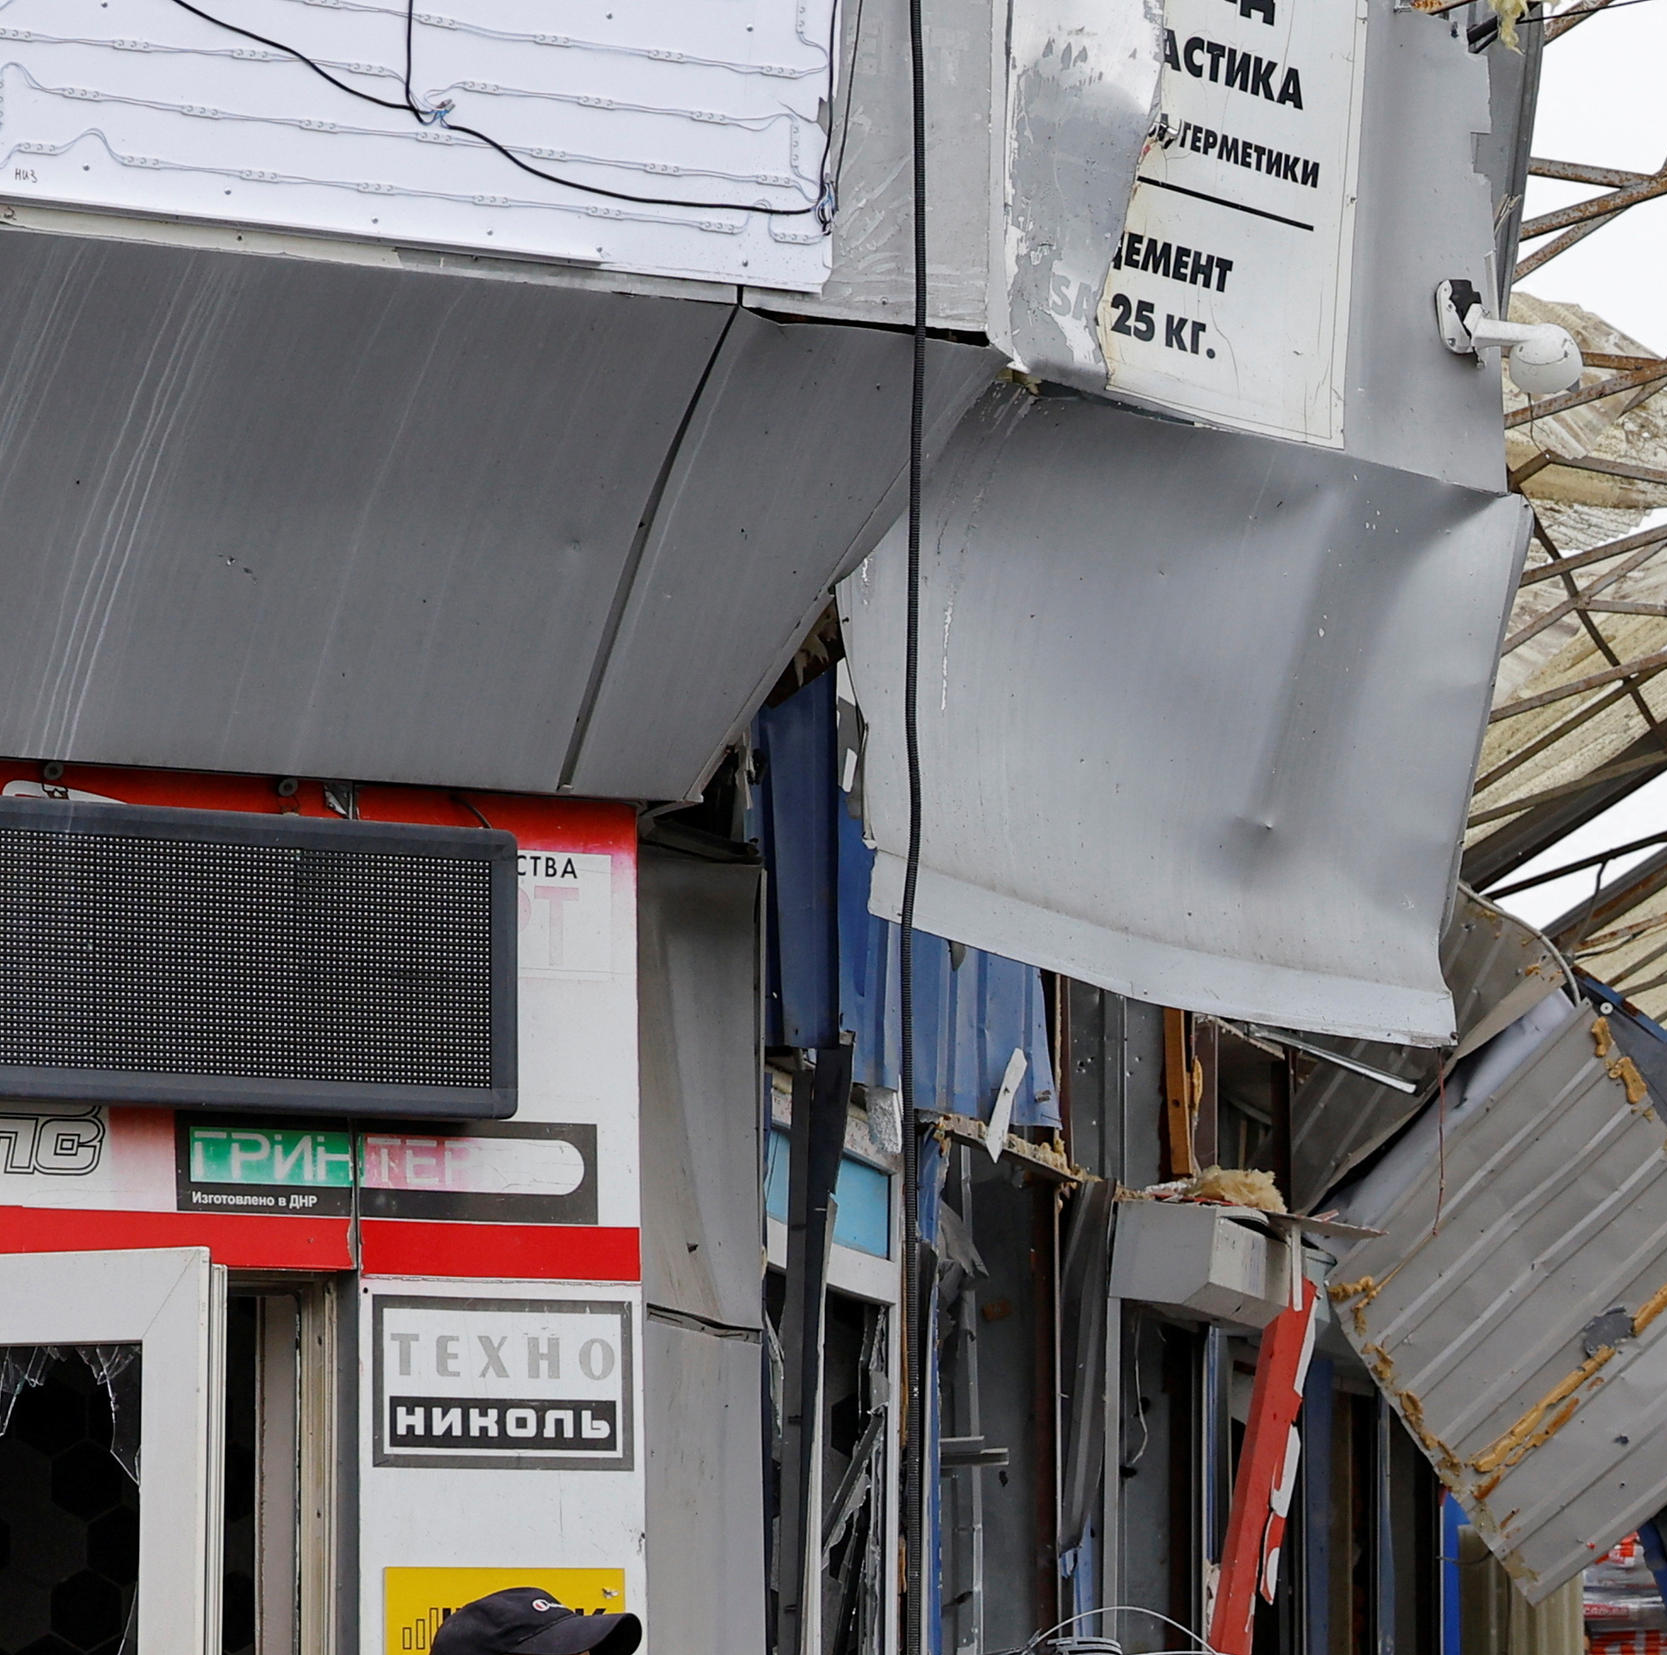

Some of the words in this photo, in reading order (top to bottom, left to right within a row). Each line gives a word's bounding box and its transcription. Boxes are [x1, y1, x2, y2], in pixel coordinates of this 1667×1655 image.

[1110, 293, 1157, 343] 25
[191, 1190, 275, 1208] Изготовлено
[277, 1195, 287, 1207] в
[288, 1194, 319, 1210] ДНР
[390, 1332, 615, 1381] ТЕХНО
[396, 1406, 611, 1439] НИКОЛЬ
